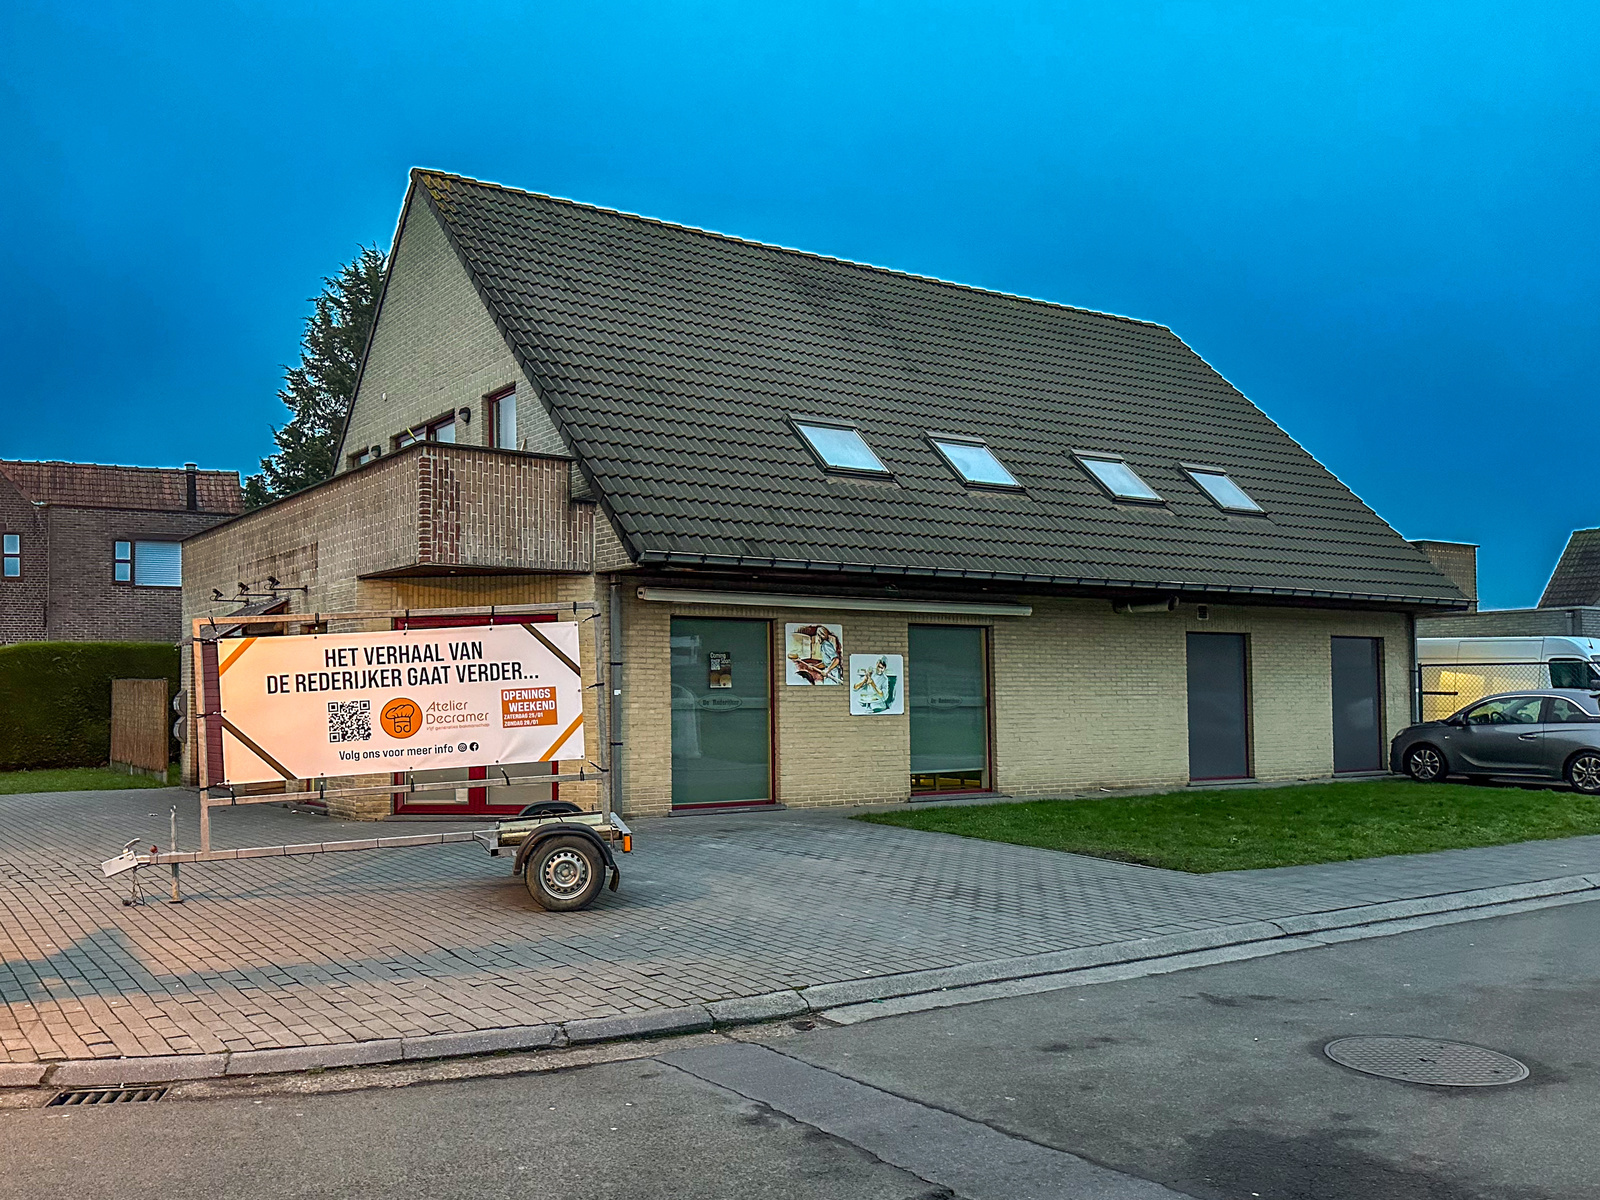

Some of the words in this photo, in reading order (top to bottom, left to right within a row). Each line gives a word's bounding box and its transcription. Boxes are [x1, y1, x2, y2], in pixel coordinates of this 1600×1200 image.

[325, 647, 359, 668] HET
[364, 643, 445, 665] VERHAAL
[448, 641, 483, 661] VAN
[266, 675, 291, 694] DE
[296, 668, 403, 692] REDERIJKER
[407, 666, 451, 687] GAAT
[456, 661, 539, 684] VERDER...
[503, 688, 551, 701] OPENINGS
[426, 700, 468, 713] Atelier
[508, 700, 555, 713] WEEKEND
[426, 712, 489, 725] Decramer
[339, 750, 361, 762] Volg
[363, 749, 380, 759] ons
[382, 748, 404, 758] voor
[407, 746, 431, 756] meer
[434, 743, 454, 755] info
